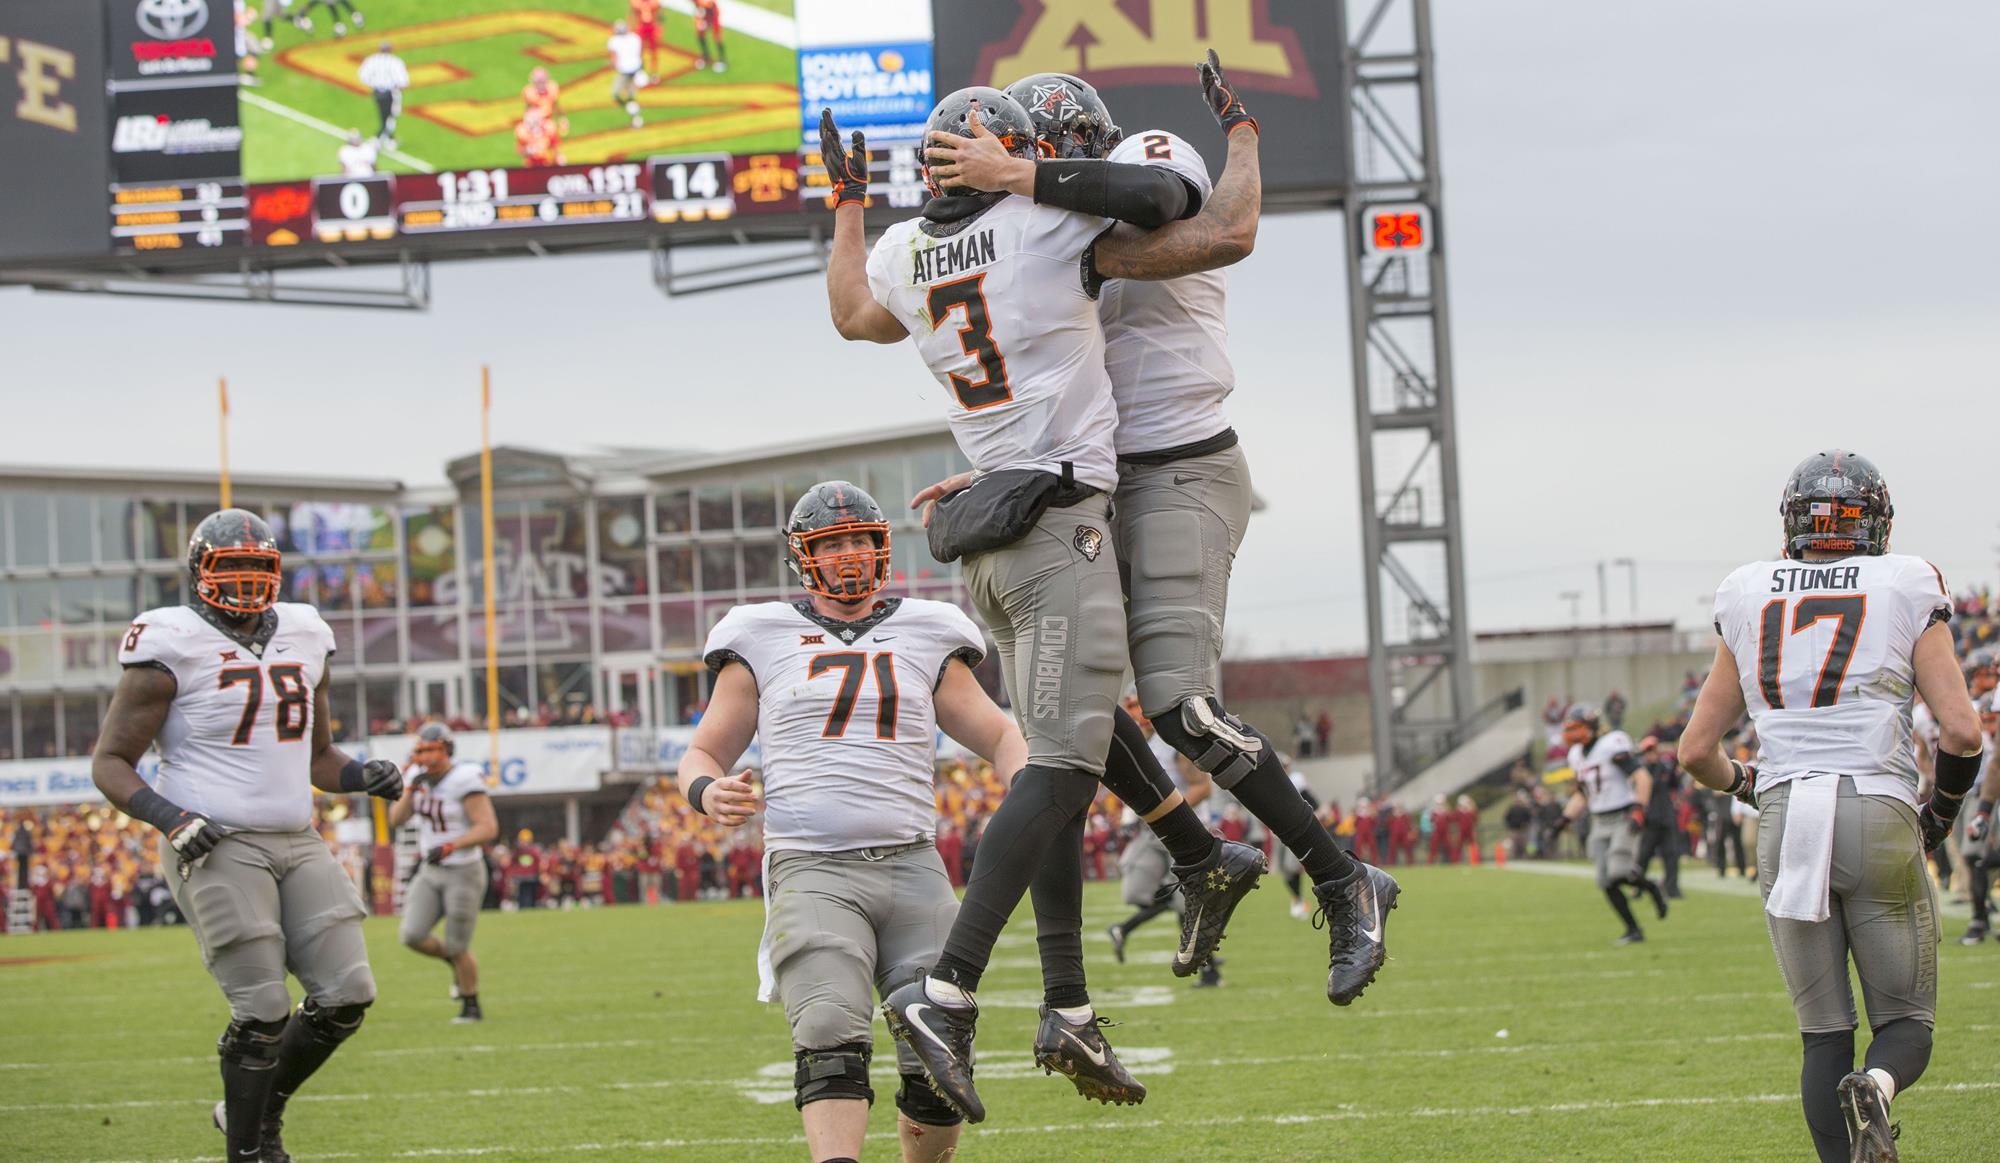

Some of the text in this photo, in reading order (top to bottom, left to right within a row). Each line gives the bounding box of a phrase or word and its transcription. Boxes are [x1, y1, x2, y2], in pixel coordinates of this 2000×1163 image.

[801, 53, 877, 79] IOWA
[803, 71, 931, 101] SOYBEAN
[1143, 135, 1171, 160] 2
[437, 169, 508, 201] 1:31
[590, 165, 641, 194] 1ST
[666, 162, 718, 200] 14
[340, 183, 370, 220] 0
[1375, 212, 1422, 249] 25
[913, 229, 996, 285] ATEMAN
[927, 272, 1013, 411] 3
[1815, 516, 1830, 532] 17
[1811, 538, 1856, 551] COWBOYS
[1771, 566, 1859, 592] STONER
[1033, 616, 1068, 720] COWBOYS
[1757, 594, 1866, 710] 17
[218, 663, 309, 746] 78
[808, 651, 899, 741] 71
